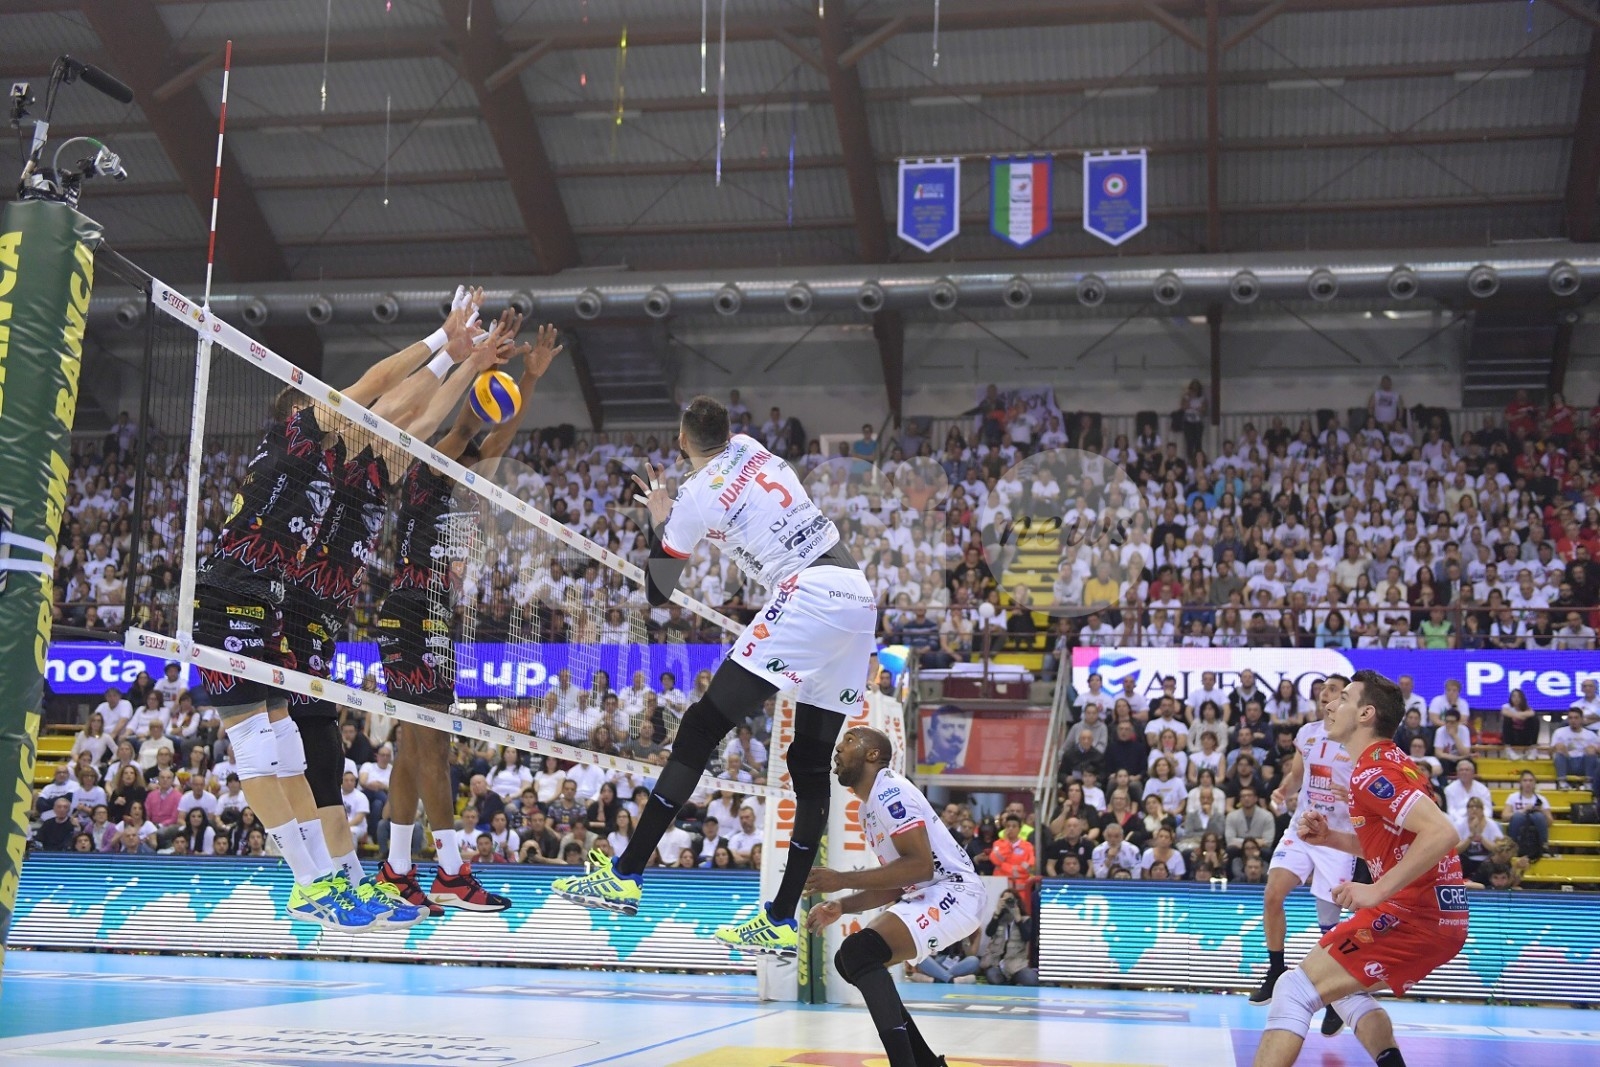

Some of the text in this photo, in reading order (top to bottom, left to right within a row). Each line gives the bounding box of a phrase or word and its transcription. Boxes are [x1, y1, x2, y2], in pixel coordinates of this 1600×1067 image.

[55, 240, 94, 432] BANCA
[755, 472, 793, 509] 5
[742, 642, 756, 657] 5
[1352, 766, 1383, 785] beko
[878, 786, 901, 802] beko
[6, 711, 41, 912] BANCA
[915, 913, 930, 930] 13
[1338, 938, 1361, 955] 17
[172, 1033, 512, 1052] ALIMENTARE
[276, 1029, 486, 1042] GRUPPO
[96, 1038, 518, 1062] VALTIBERINO
